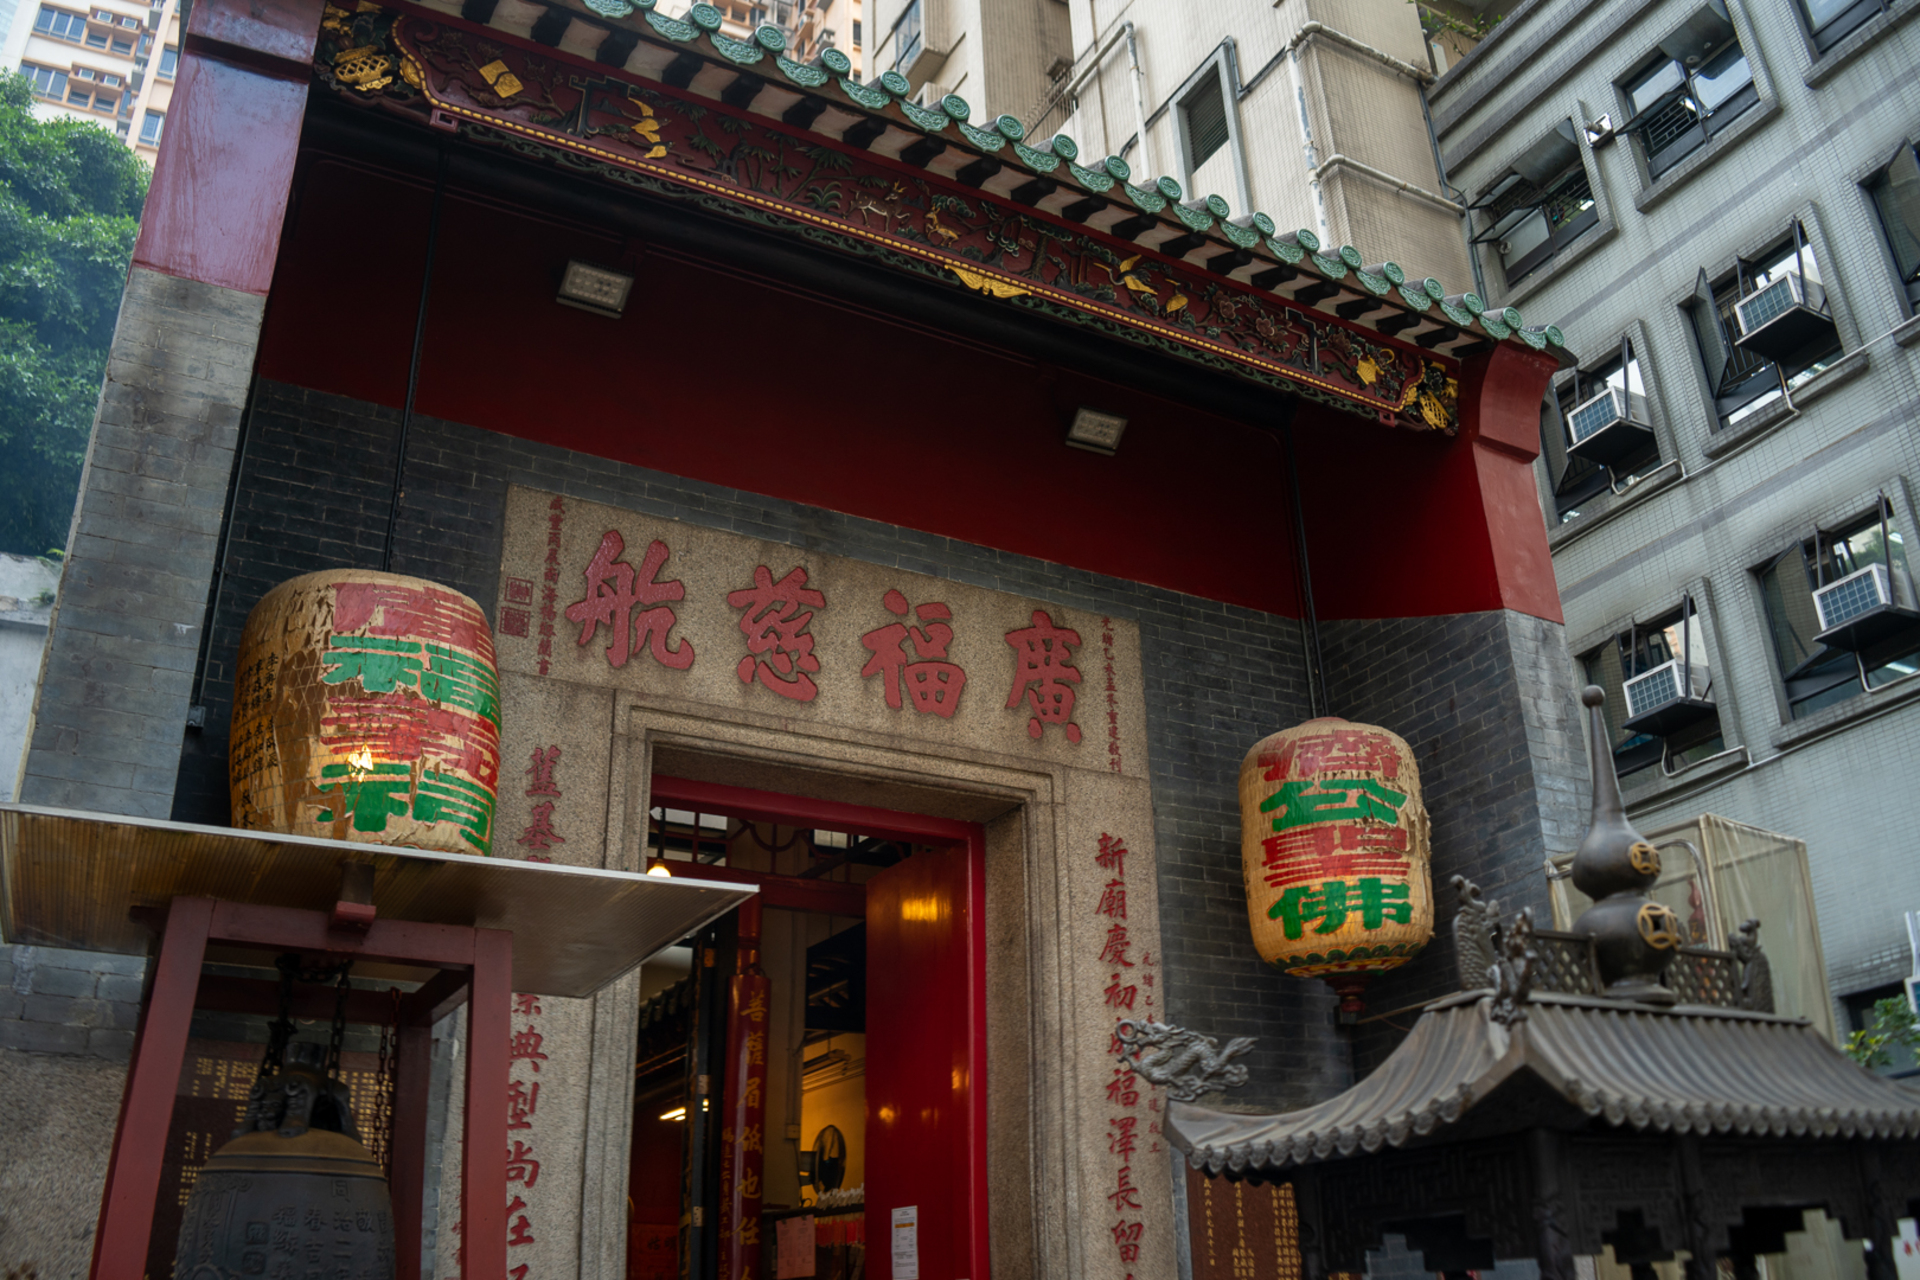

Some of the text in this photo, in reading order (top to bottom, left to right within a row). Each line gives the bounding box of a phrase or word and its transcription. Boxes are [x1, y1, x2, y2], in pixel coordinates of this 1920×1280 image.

[565, 529, 1082, 743] 廣福慈航
[517, 745, 566, 864] 舊基
[1095, 832, 1143, 1280] 新廟慶初福澤長留
